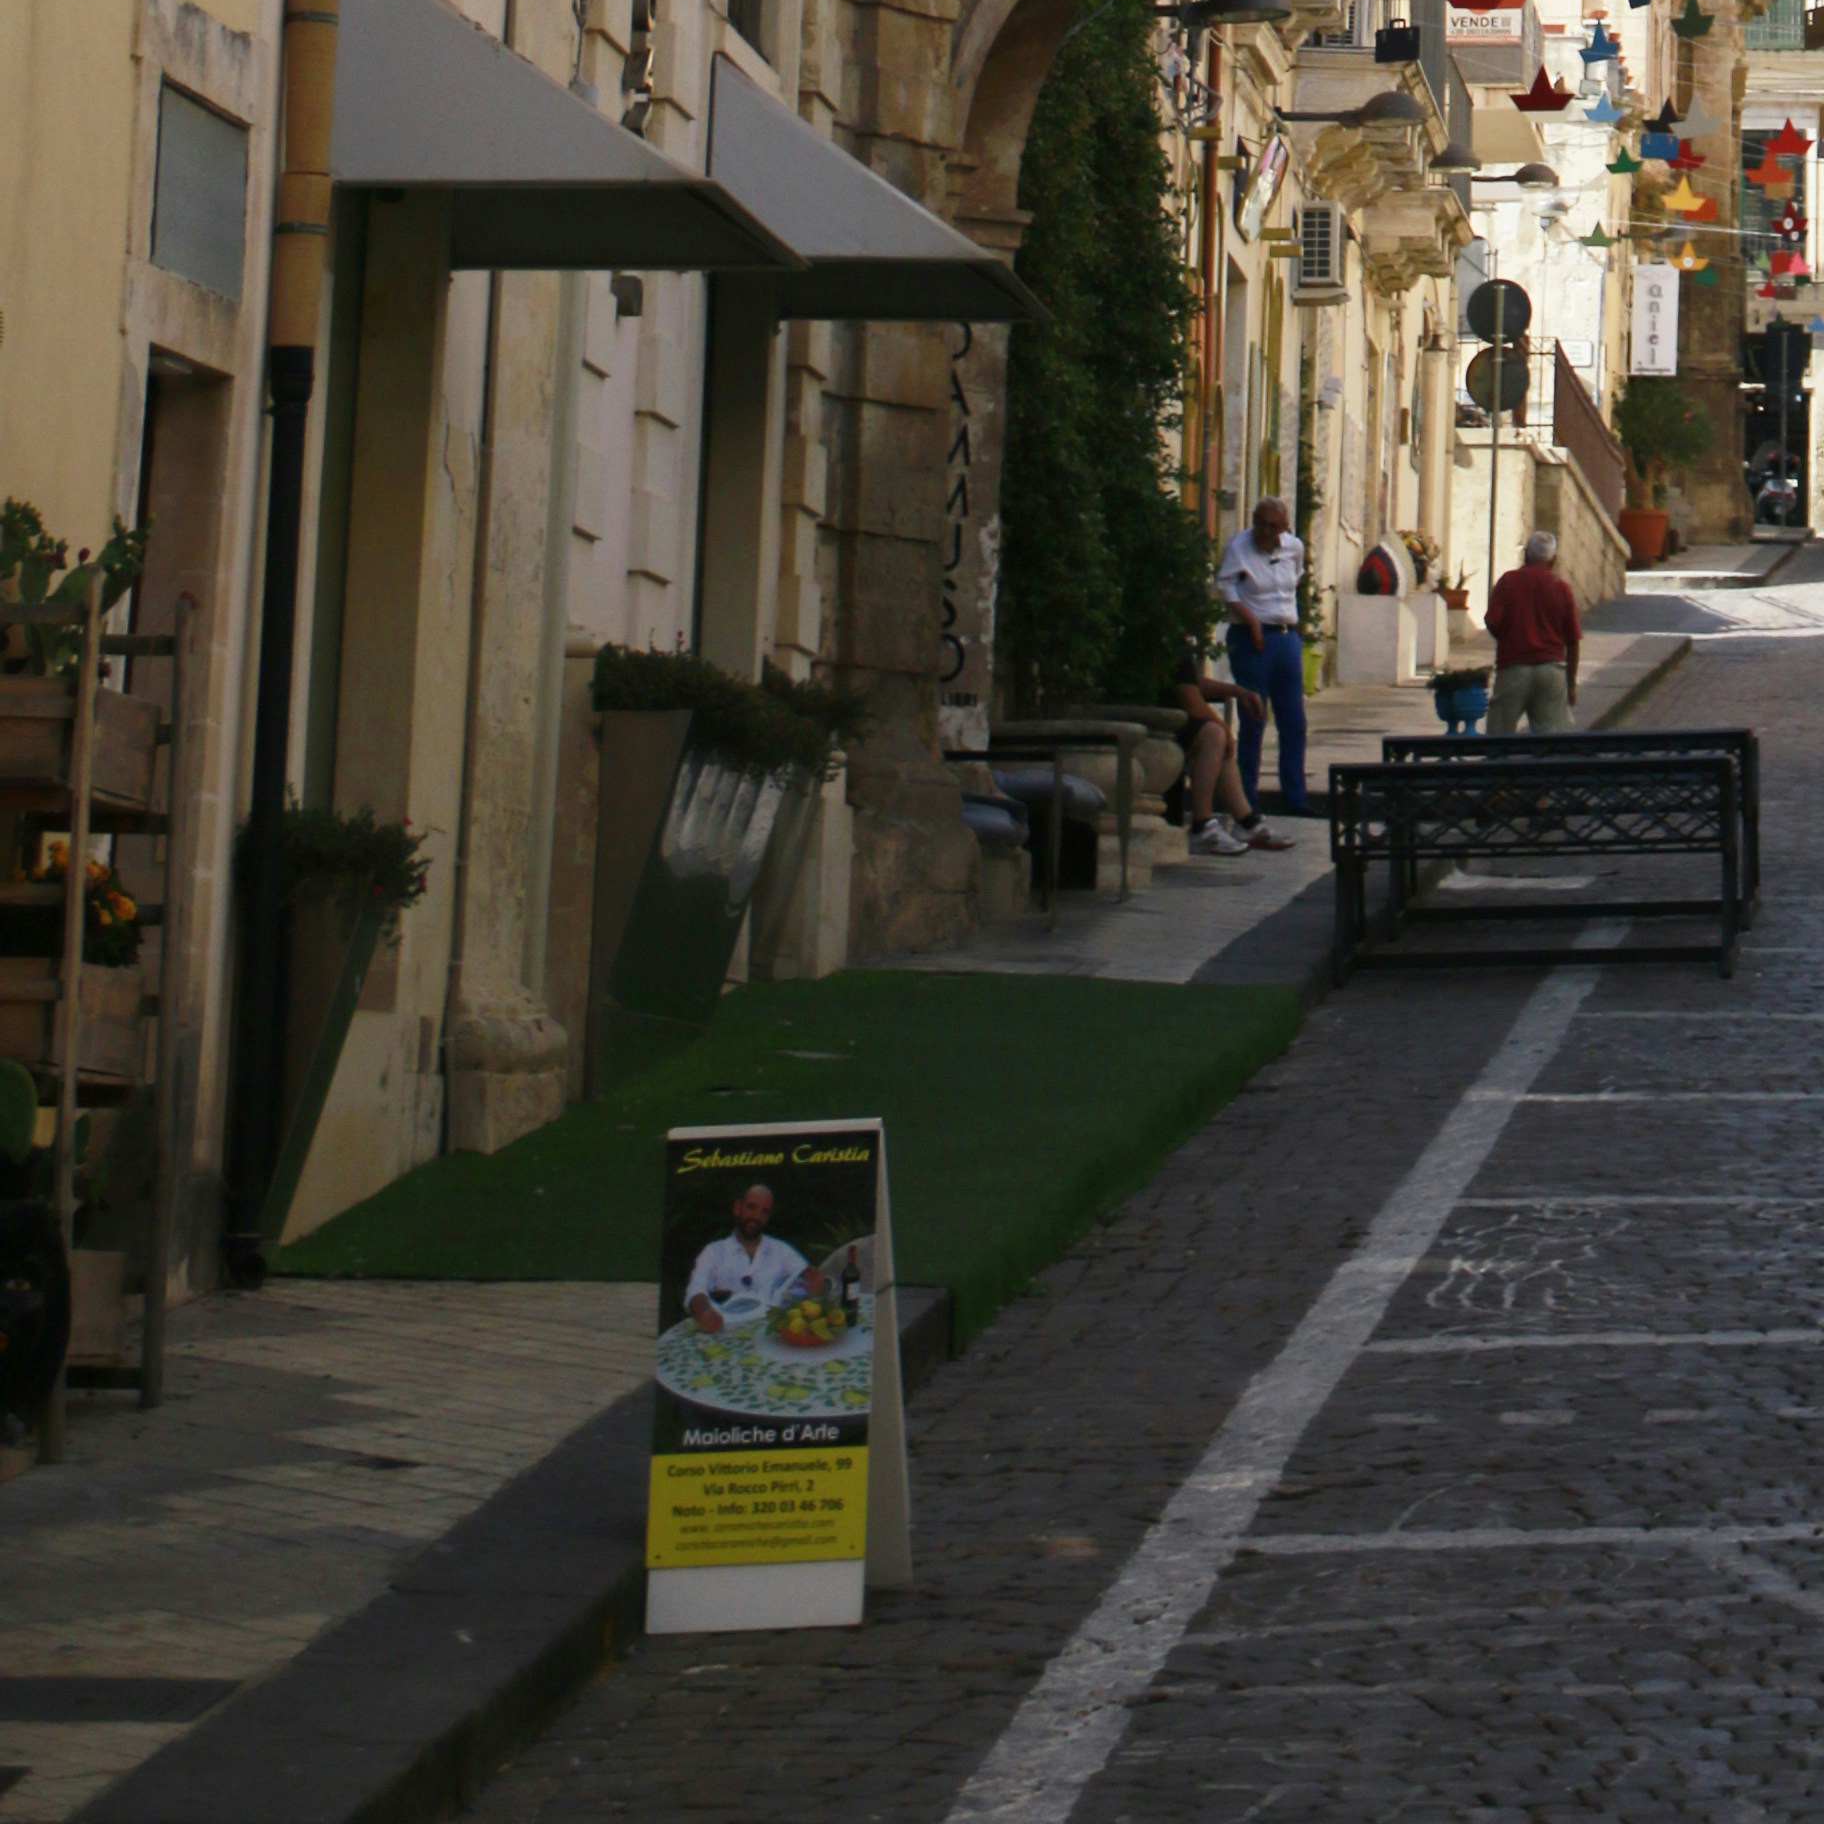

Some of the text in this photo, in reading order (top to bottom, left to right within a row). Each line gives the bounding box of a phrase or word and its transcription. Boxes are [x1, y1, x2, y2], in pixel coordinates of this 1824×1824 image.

[1450, 16, 1500, 28] VENDE
[674, 1143, 871, 1174] Sebastiano Caristia
[682, 1426, 777, 1446] Maioliche
[667, 1457, 854, 1477] Corso Vittorio Emanuele, 99
[703, 1483, 724, 1496] Via
[728, 1482, 768, 1494] Rocco
[806, 1479, 815, 1491] 2
[672, 1504, 706, 1517] Noto
[717, 1502, 748, 1515] Info:
[752, 1501, 776, 1514] 320
[780, 1500, 796, 1512] 03
[799, 1499, 816, 1511] 46
[820, 1498, 845, 1510] 706
